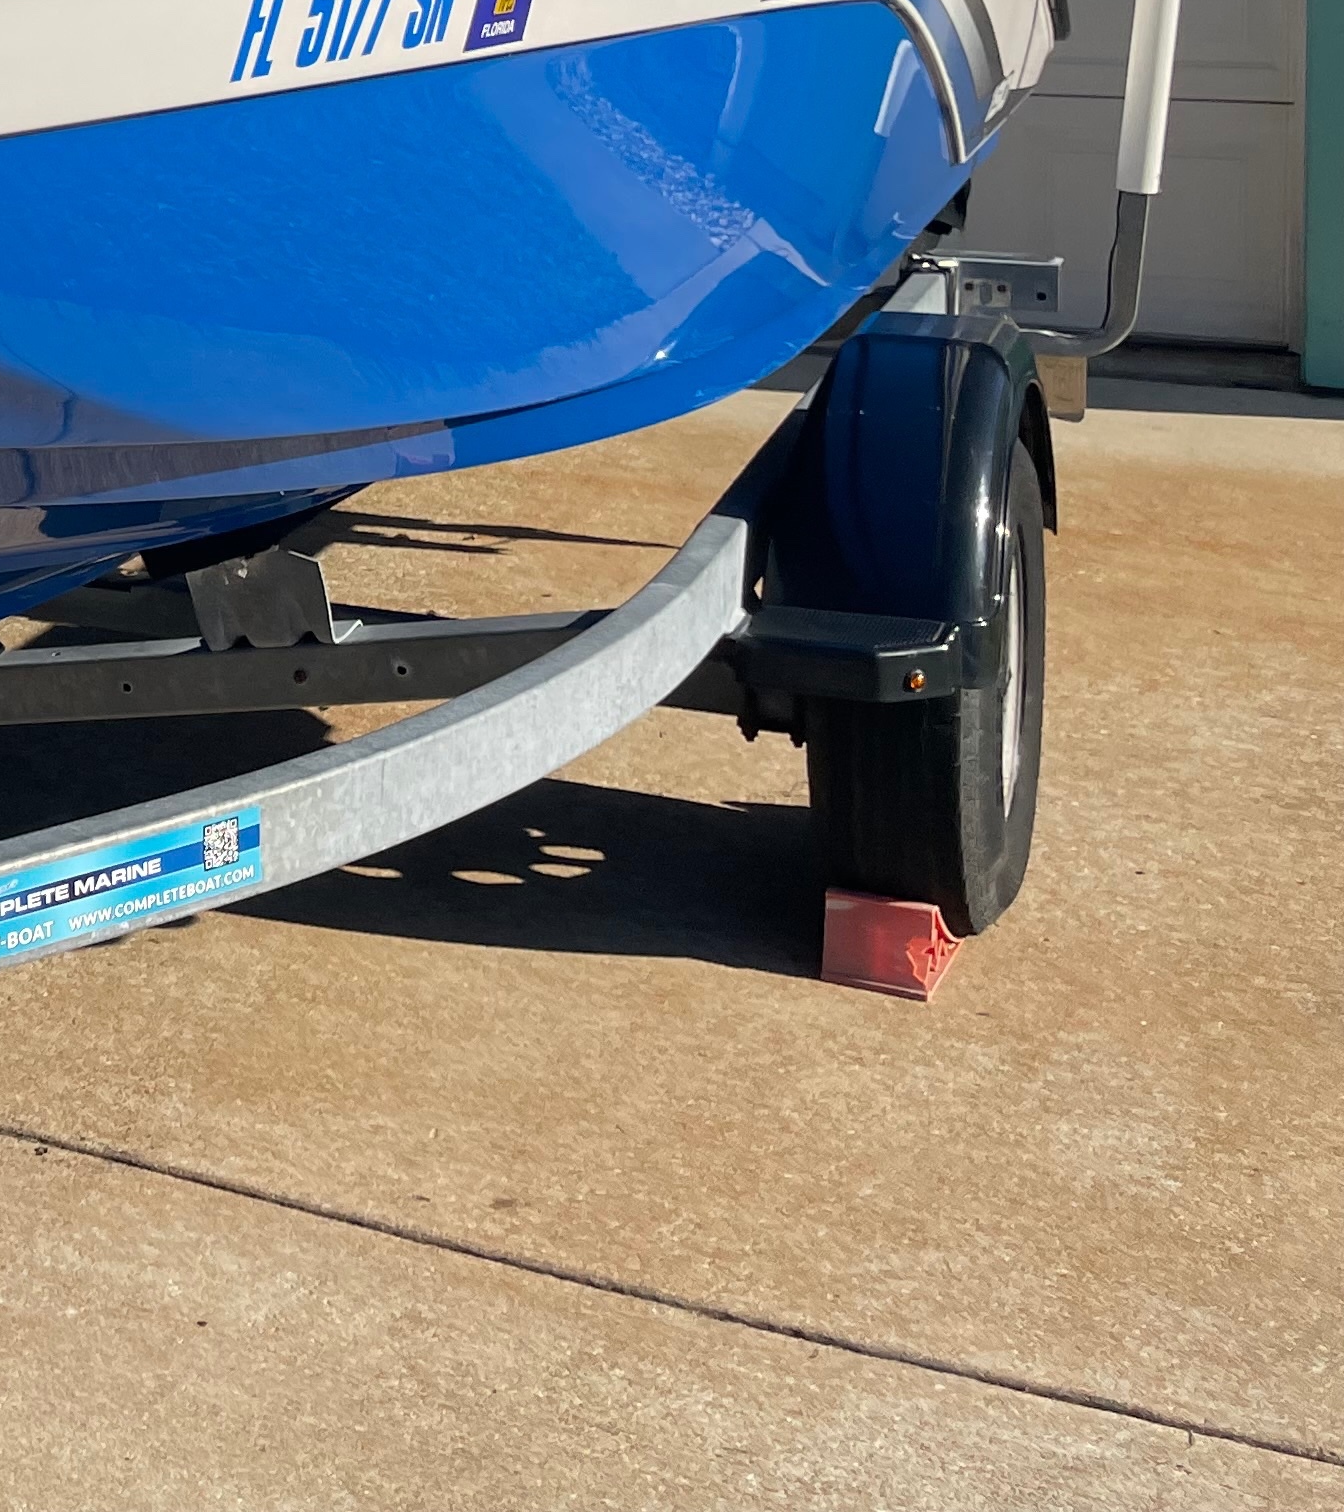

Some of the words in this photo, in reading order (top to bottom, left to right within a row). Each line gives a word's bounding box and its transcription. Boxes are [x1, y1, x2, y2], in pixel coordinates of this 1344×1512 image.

[480, 18, 515, 39] FLORIDA
[73, 857, 162, 897] MARINE
[68, 864, 255, 932] WWW.COMPLETEBOAT.COM
